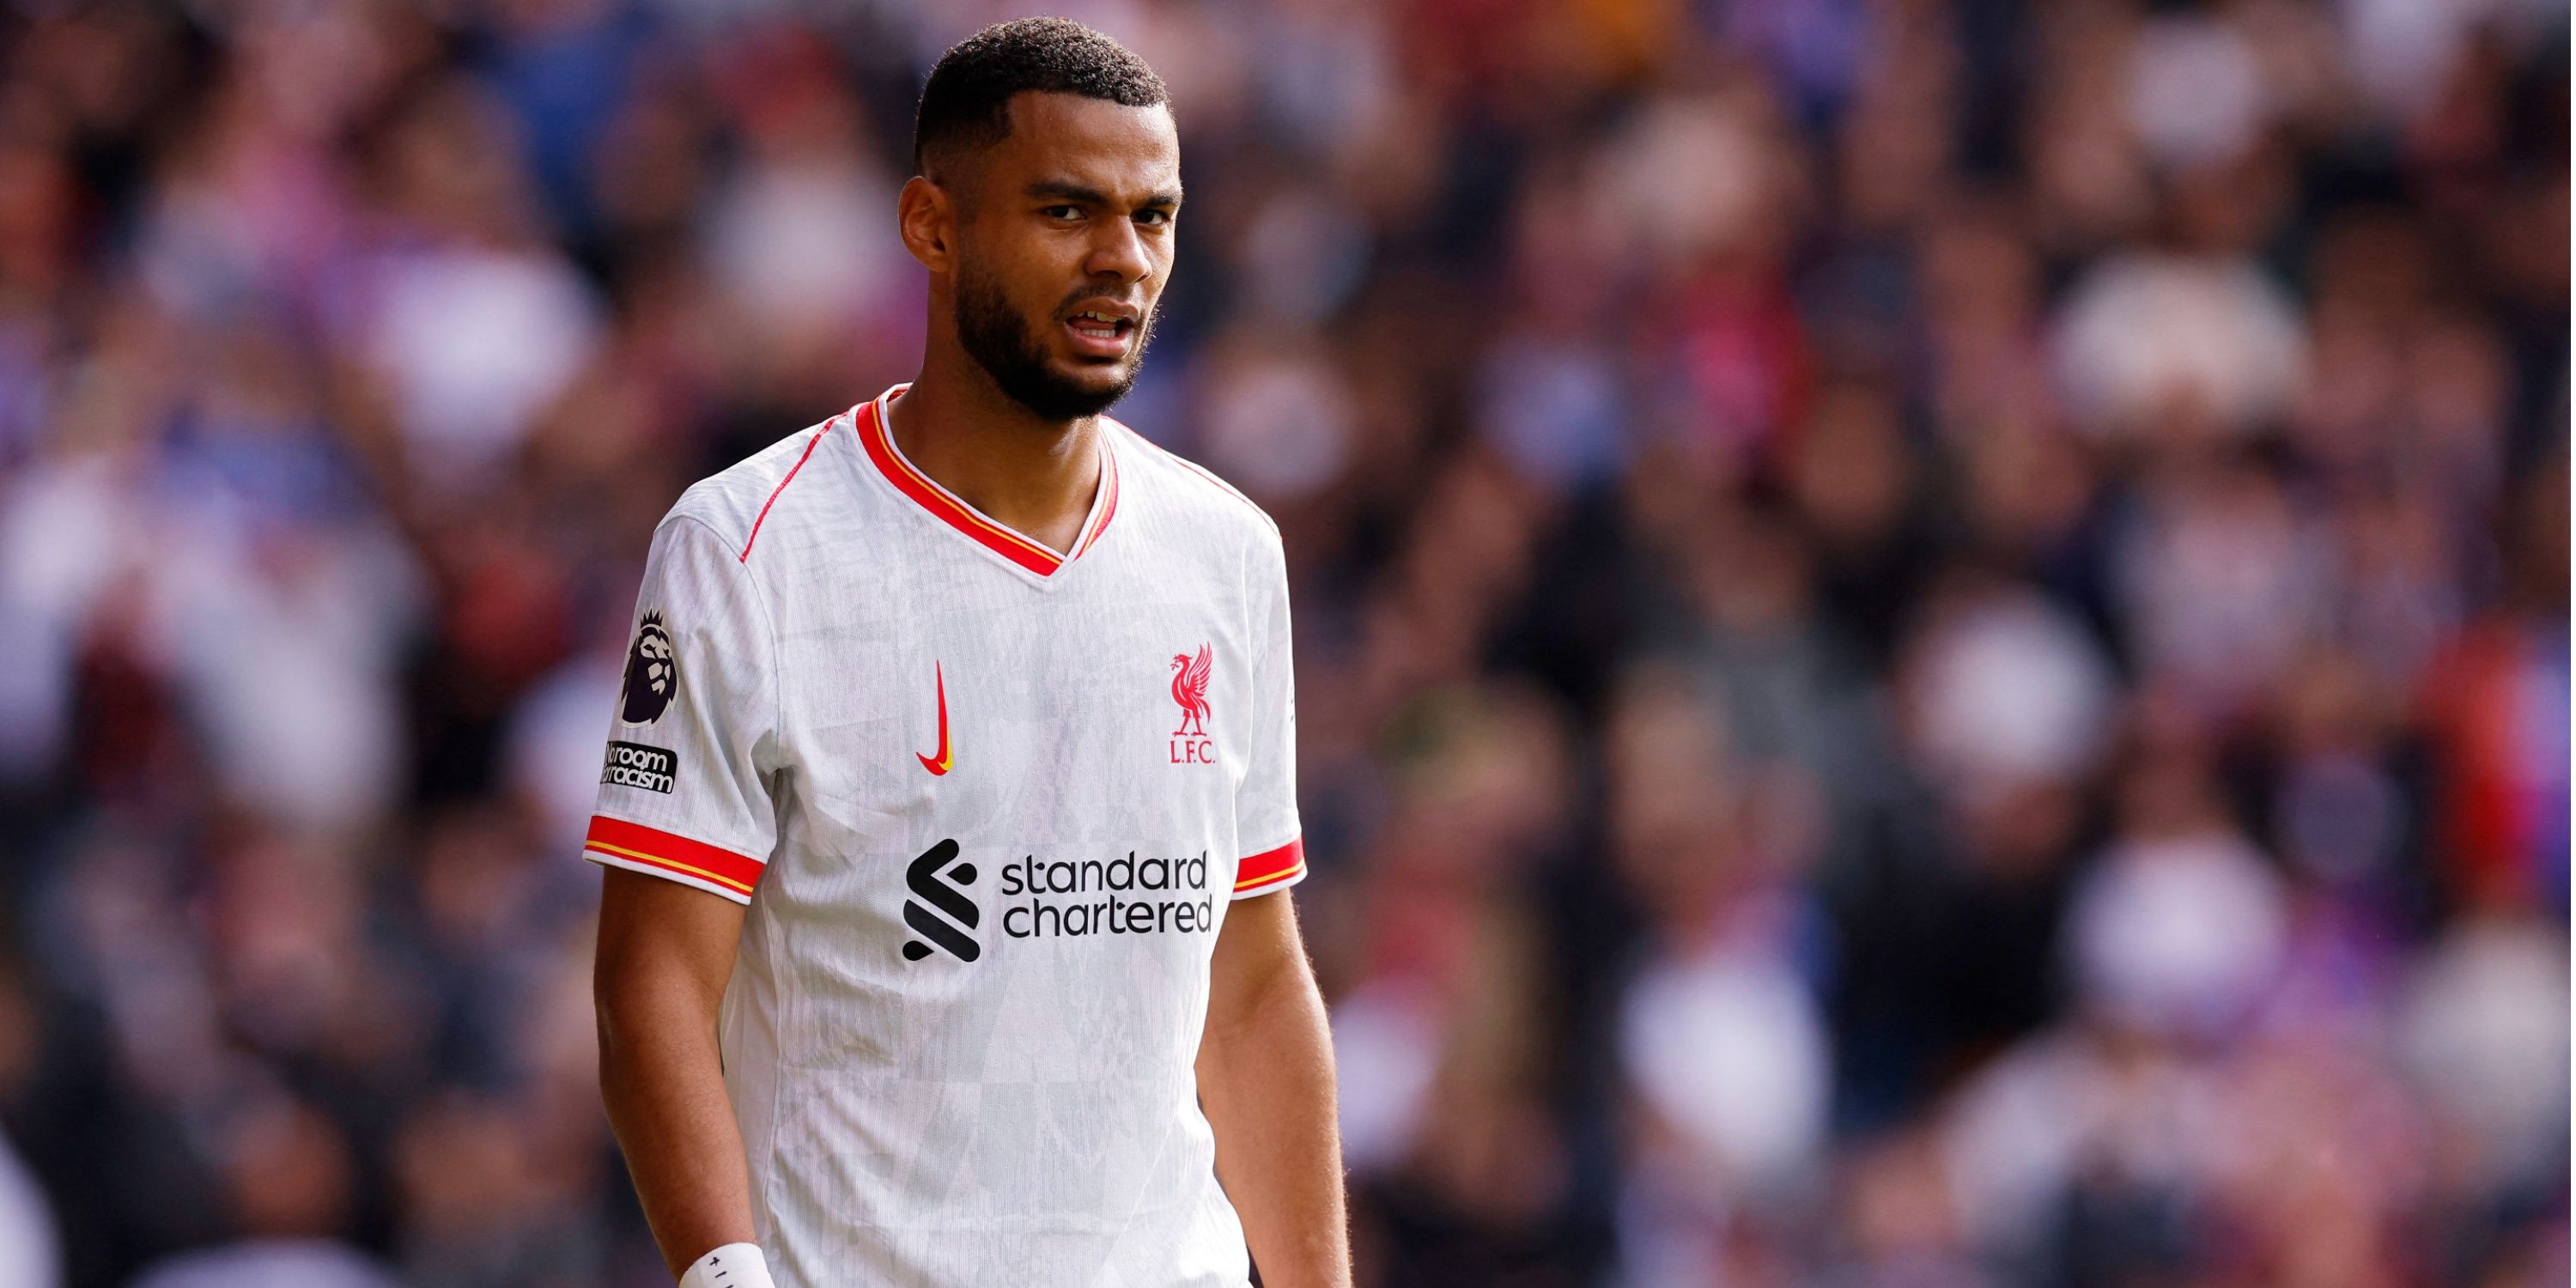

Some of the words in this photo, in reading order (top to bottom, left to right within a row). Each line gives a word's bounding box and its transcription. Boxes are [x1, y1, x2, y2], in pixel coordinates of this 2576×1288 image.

[614, 746, 668, 773] room
[1170, 740, 1216, 763] L.F.C.
[608, 766, 673, 793] racism
[1002, 850, 1207, 896] standard
[1003, 893, 1212, 939] chartered
